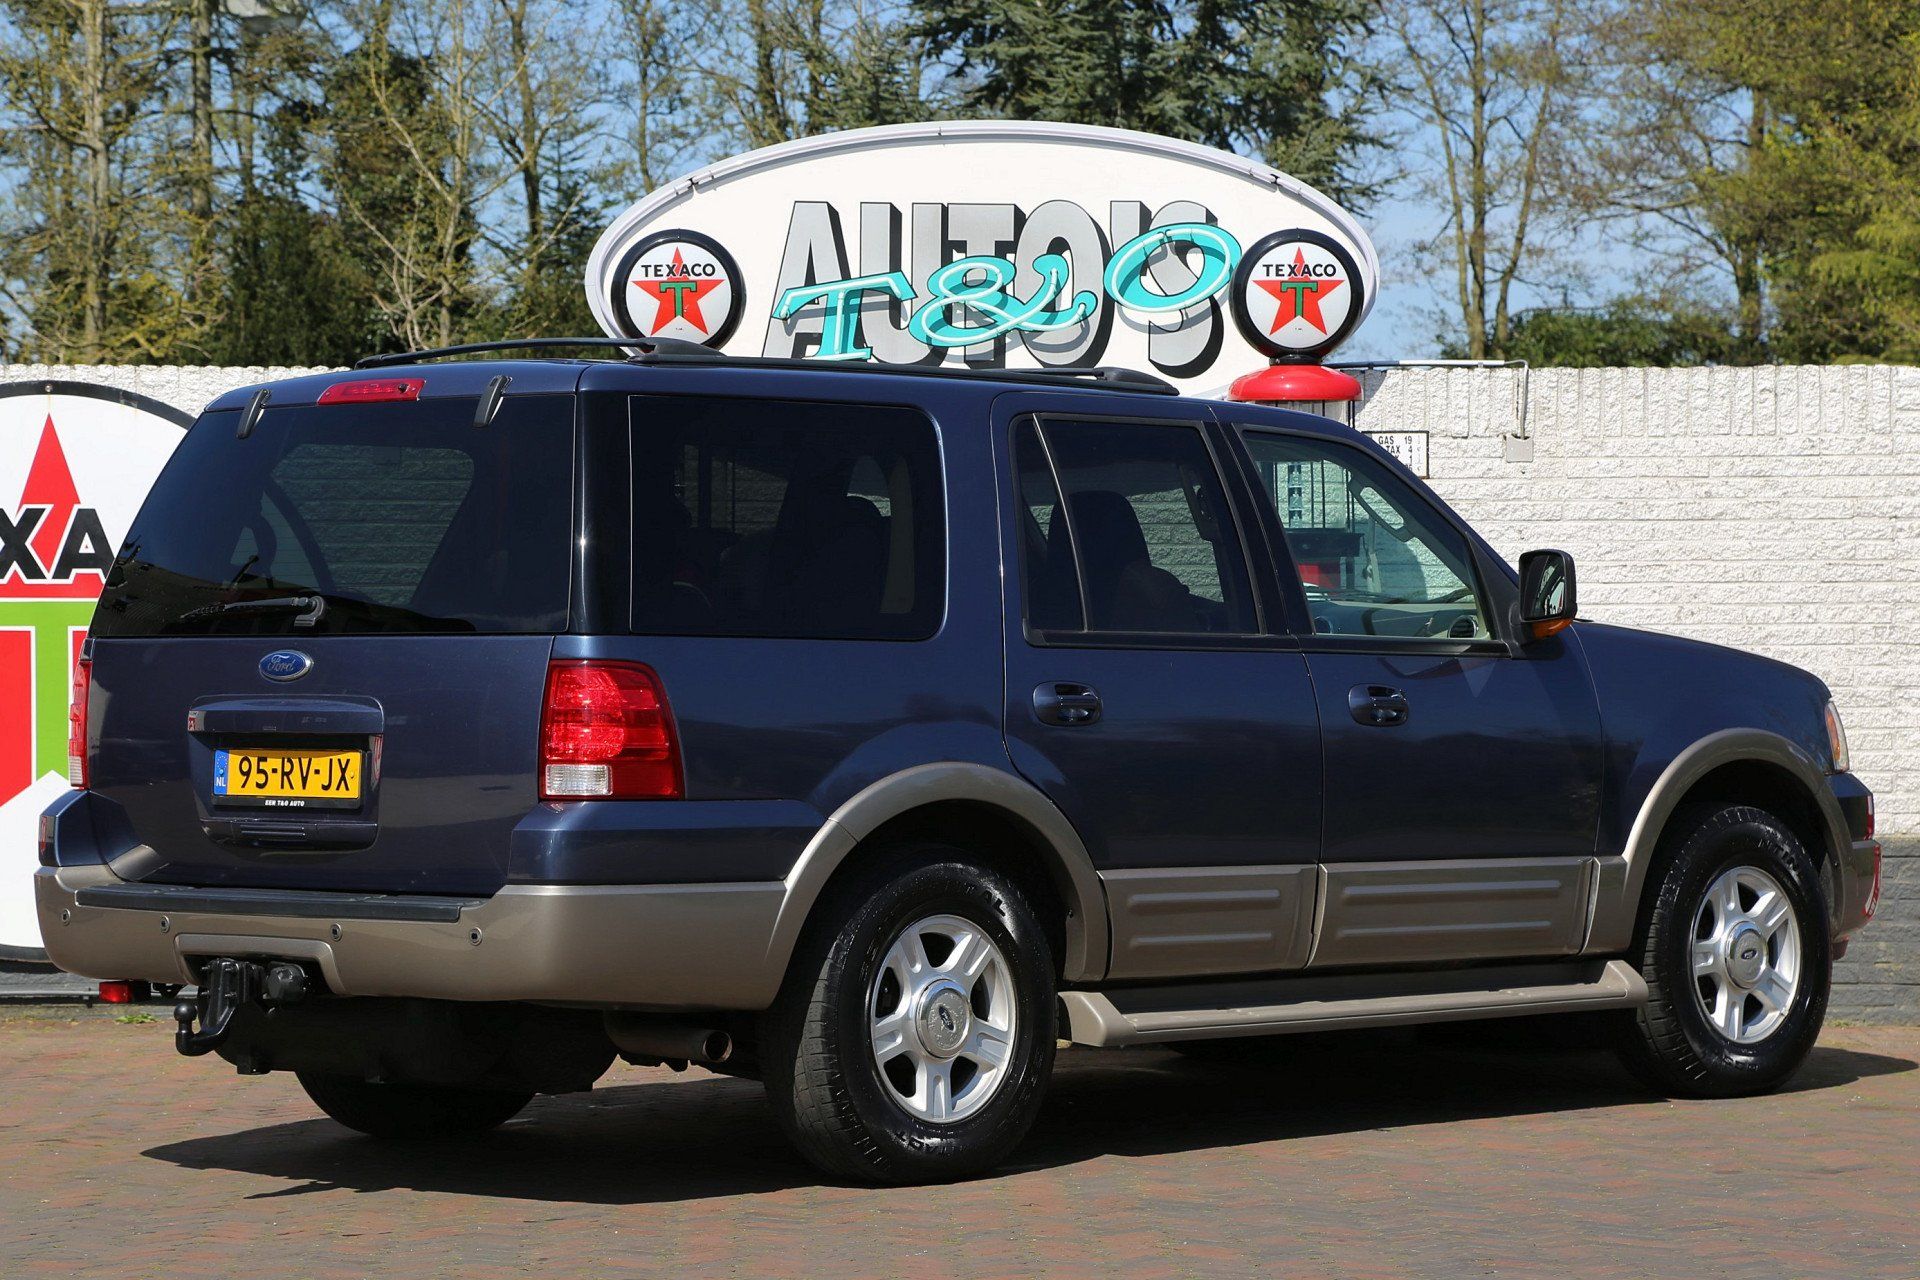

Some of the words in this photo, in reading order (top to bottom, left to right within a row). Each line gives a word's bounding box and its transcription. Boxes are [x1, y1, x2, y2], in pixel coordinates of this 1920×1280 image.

[641, 263, 716, 277] TEXACO
[1262, 264, 1337, 277] TEXACO
[762, 200, 1225, 379] AUTO'S
[659, 281, 698, 317] T
[1280, 281, 1318, 318] T
[1378, 435, 1395, 445] GAS
[1404, 435, 1412, 445] 19
[1386, 445, 1400, 454] TAX
[1408, 445, 1412, 454] 4
[268, 654, 296, 672] Ford
[238, 755, 351, 791] 95-RV-JX
[215, 777, 226, 787] NL
